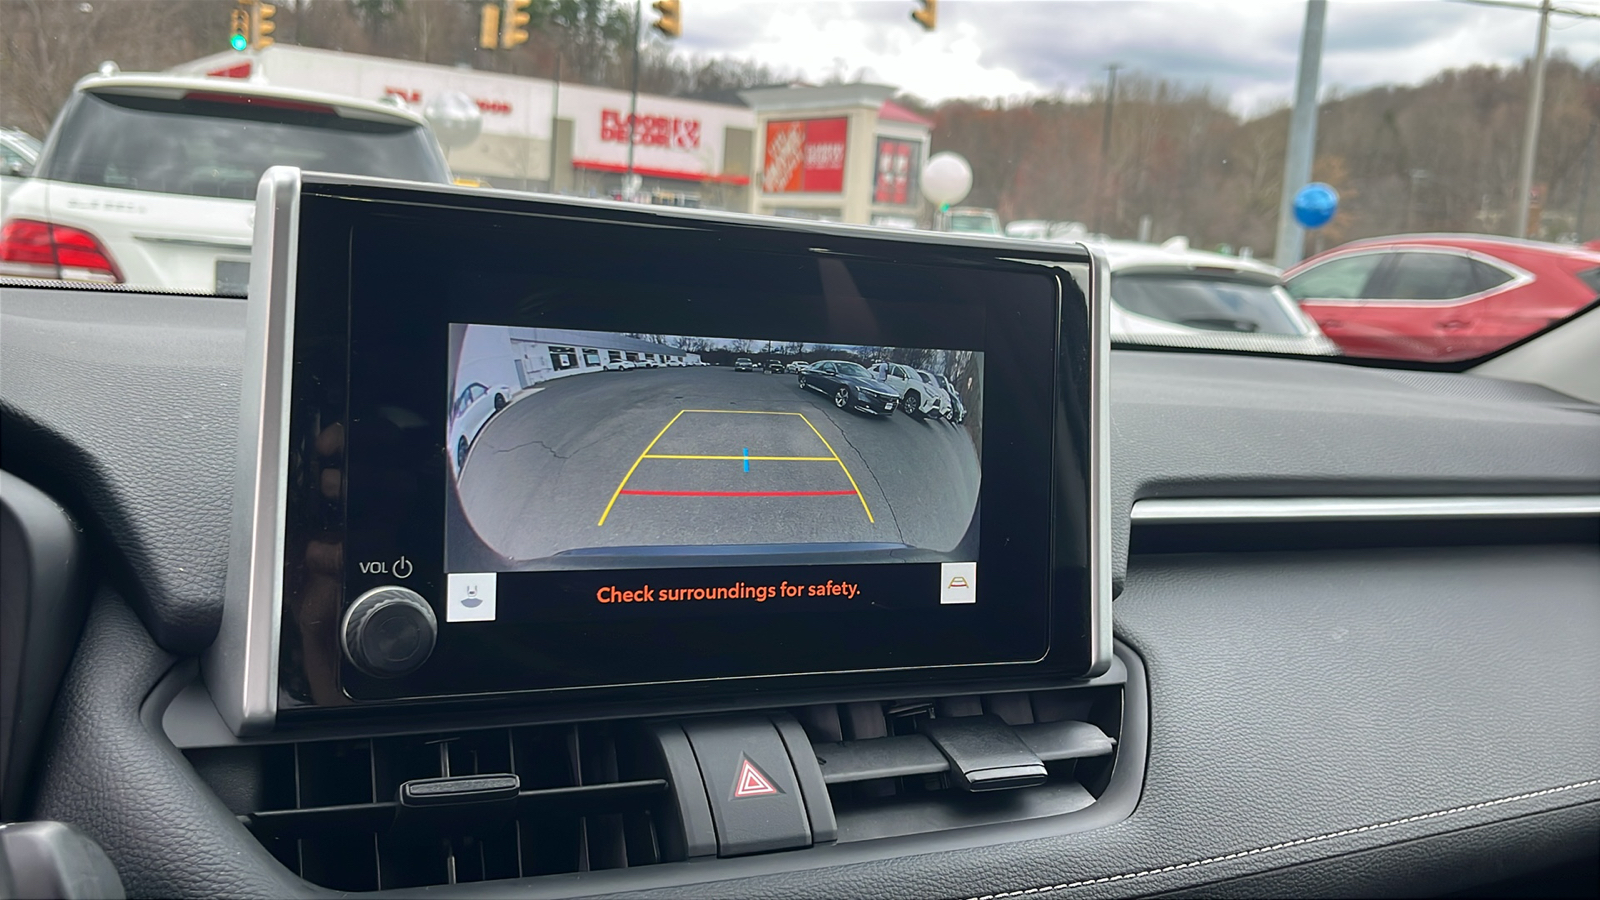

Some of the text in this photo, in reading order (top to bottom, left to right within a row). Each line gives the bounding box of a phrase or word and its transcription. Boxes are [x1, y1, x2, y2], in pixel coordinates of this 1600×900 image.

[359, 561, 389, 574] VOL
[596, 579, 861, 603] Check surroundings for safety.
